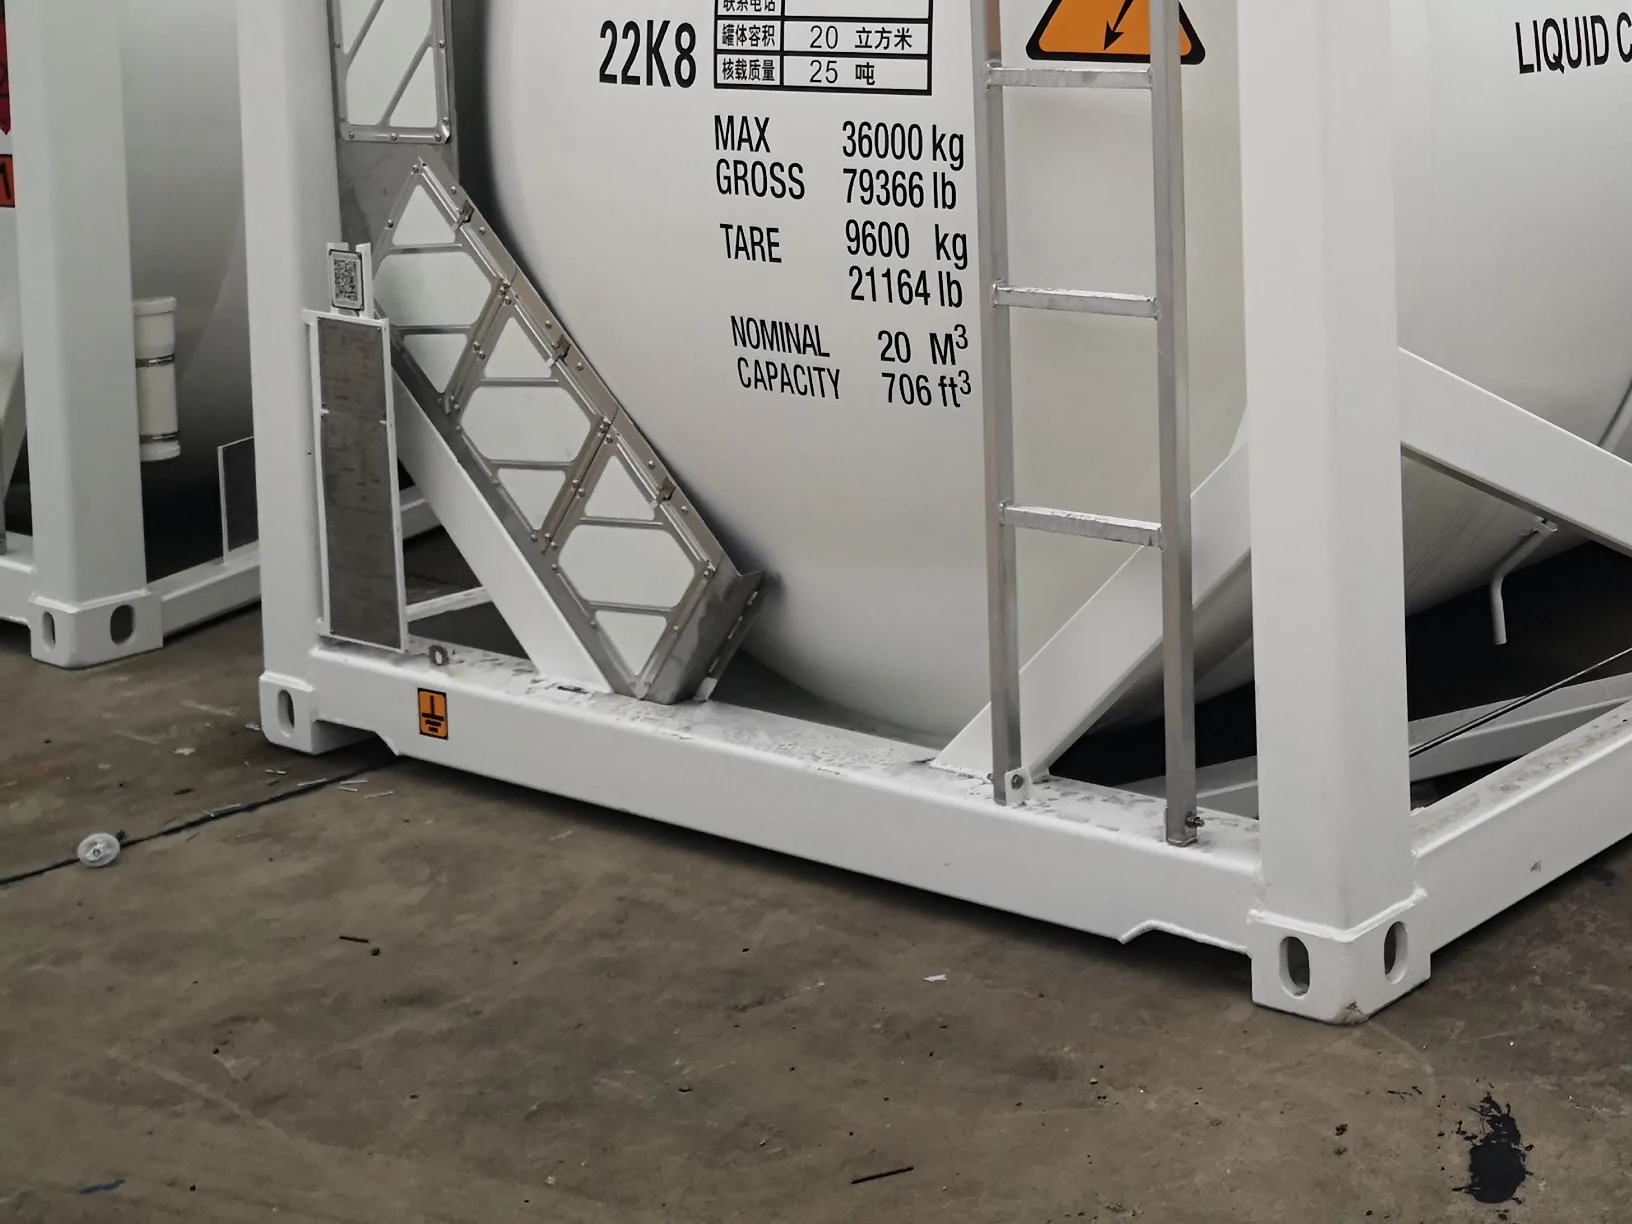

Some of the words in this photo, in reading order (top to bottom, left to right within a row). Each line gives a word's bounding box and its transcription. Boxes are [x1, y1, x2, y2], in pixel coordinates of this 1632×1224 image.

[599, 20, 696, 88] 22K8
[722, 24, 775, 48] 罐体容积
[809, 26, 838, 49] 20
[854, 27, 912, 50] 立方米
[1515, 15, 1609, 74] LIQUID
[722, 59, 775, 83] 核载质量
[809, 60, 838, 84] 25
[855, 62, 876, 85] 吨
[714, 115, 771, 153] MAX
[842, 121, 922, 160] 36000
[932, 125, 964, 171] kg
[716, 159, 805, 199] GROSS
[842, 168, 924, 208] 79366
[933, 172, 957, 209] lb
[720, 223, 782, 263] TARE
[846, 219, 910, 259] 9600
[935, 224, 968, 270] kg
[849, 266, 930, 306] 21164
[938, 271, 962, 308] lb
[731, 315, 830, 357] NOMINAL
[877, 330, 911, 363] 20
[737, 357, 840, 399] CAPACITY
[881, 372, 932, 406] 706
